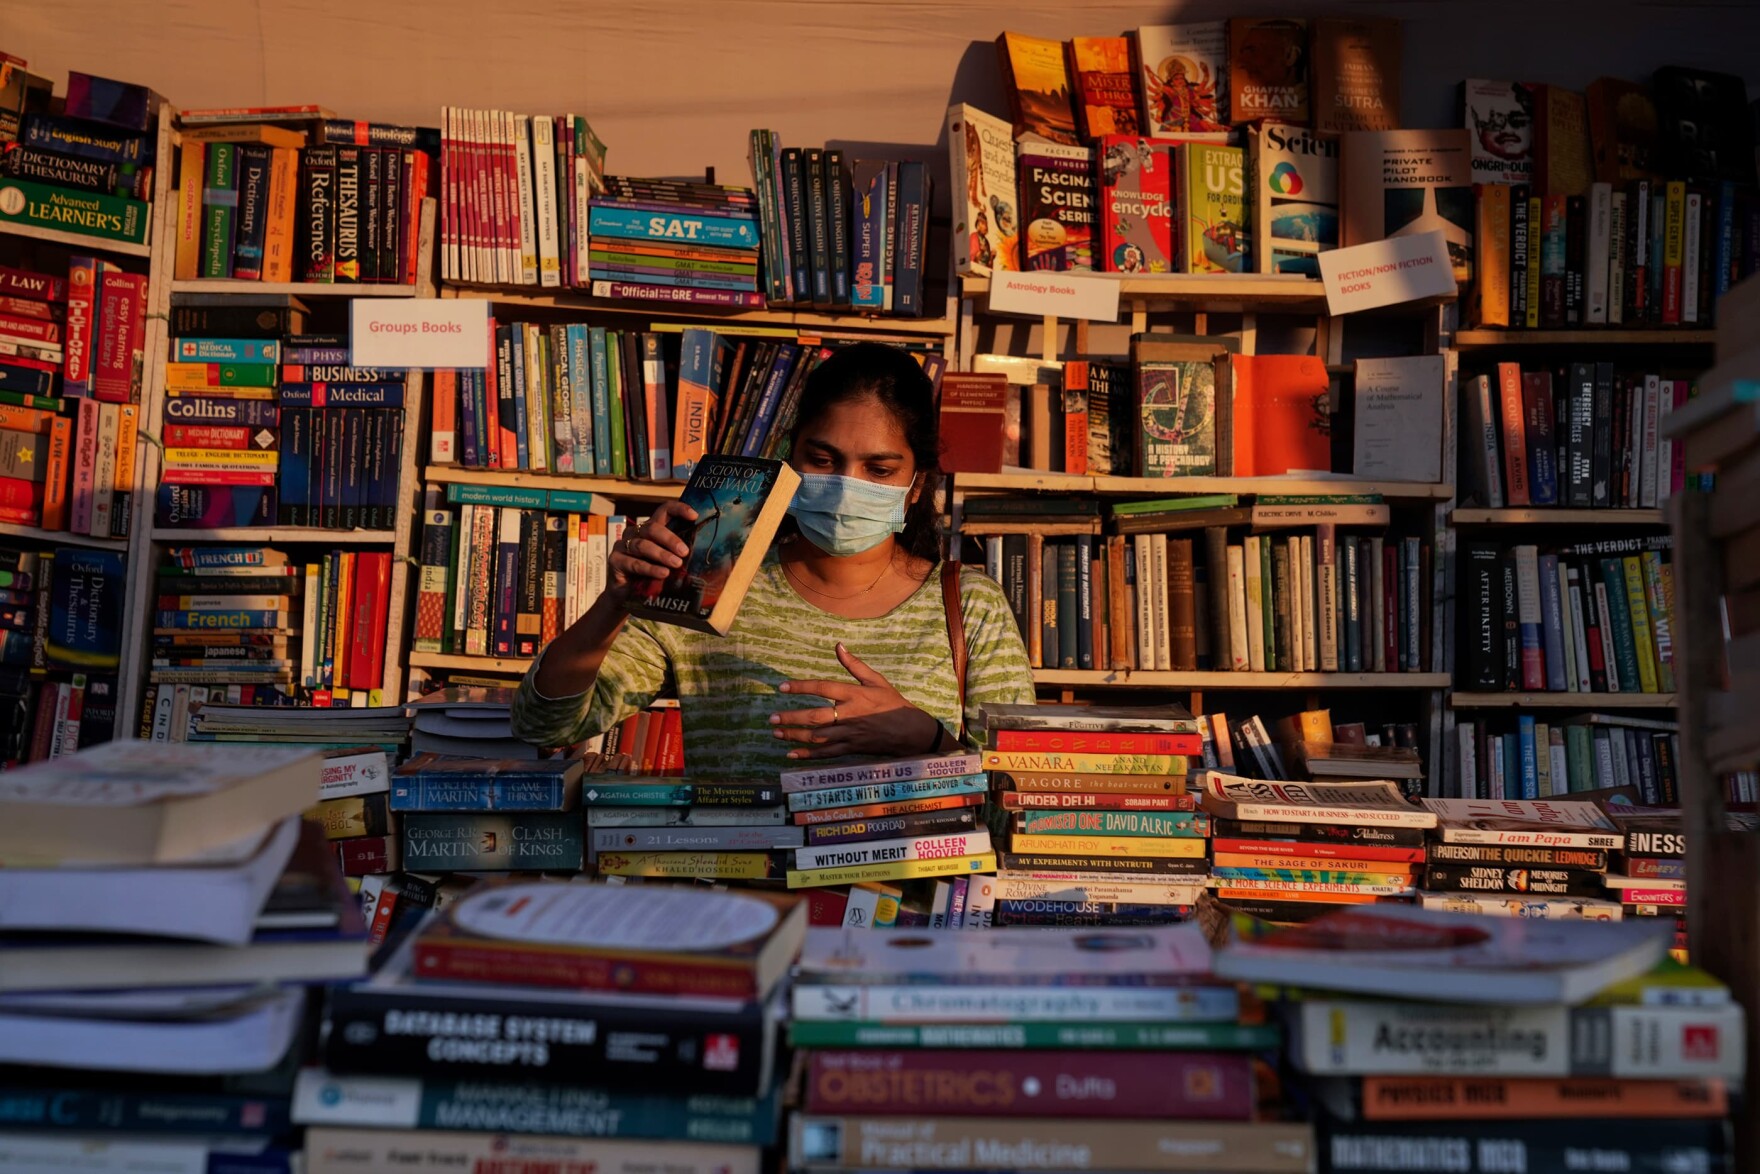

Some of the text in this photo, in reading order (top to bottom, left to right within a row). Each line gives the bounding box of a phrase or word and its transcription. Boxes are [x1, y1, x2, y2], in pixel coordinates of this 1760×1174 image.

[1244, 86, 1294, 94] GHAFFAR
[1241, 94, 1299, 108] KHAN
[1335, 95, 1383, 109] SUTRA
[325, 126, 416, 143] Oxford Biology
[1045, 148, 1072, 156] FACTS
[23, 151, 108, 176] DICTIONARY
[216, 147, 226, 185] Oxford
[22, 163, 98, 186] THESAURUS
[1383, 175, 1453, 183] HANDBOOK
[50, 193, 100, 212] Advanced
[242, 166, 261, 234] Dictionary
[887, 181, 896, 219] SECRETS
[1110, 190, 1164, 202] KNOWLEDGE
[29, 202, 122, 231] LEARNER'S
[311, 171, 330, 262] Reference
[338, 165, 358, 258] THESAURUS
[649, 217, 702, 239] SAT
[1515, 202, 1526, 266] THE VERDICT
[211, 209, 224, 275] Encyclopedia
[885, 226, 895, 271] HACKING
[675, 261, 695, 269] GMAT
[855, 222, 873, 300] SUPER BRAIN
[1338, 256, 1433, 281] FICTION/NON FICTION
[11, 275, 45, 291] LAW
[105, 278, 135, 289] Collins
[1006, 281, 1076, 296] Astrology Books
[1341, 282, 1372, 294] BOOKS
[622, 287, 658, 299] Official
[672, 289, 692, 301] GRE
[695, 292, 717, 301] General
[101, 296, 118, 368] English Library
[113, 297, 130, 369] easy learning
[369, 321, 463, 334] Groups Books
[198, 350, 236, 359] Dictionary
[199, 344, 233, 352] MEDICAL
[312, 366, 378, 382] BUSINESS
[282, 384, 385, 401] Oxford Medical
[167, 400, 236, 419] Collins
[689, 401, 702, 444] INDIA
[1484, 422, 1494, 451] INDIA
[706, 464, 760, 479] SCION OF
[1513, 456, 1523, 490] ARVIND
[693, 476, 763, 493] IKSHVAKU
[169, 485, 181, 523] Oxford
[462, 492, 541, 505] modern world history
[1573, 539, 1642, 555] THE VERDICT
[201, 552, 242, 565] FRENCH
[1504, 567, 1513, 614] MELTDOWN
[66, 575, 84, 645] Thesaurus
[84, 577, 105, 643] Dictionary
[643, 595, 690, 613] AMISH
[1480, 569, 1491, 654] AFTER PIKETTY
[187, 611, 250, 627] French
[205, 647, 246, 658] japanese
[927, 759, 967, 770] COLLEEN
[1007, 755, 1075, 771] VANARA
[1112, 756, 1147, 764] ANAND
[344, 764, 357, 773] MY
[802, 766, 912, 787] IT ENDS WITH US
[929, 767, 966, 777] HOOVER
[428, 790, 478, 803] MARTIN
[506, 791, 549, 802] THRONES
[600, 791, 666, 799] AGATHA CHRISTIE
[697, 787, 755, 796] The Mysterious
[1018, 793, 1169, 807] UNDER DELHI SORABH PANT
[816, 820, 906, 838] RICH DAD POOR DAD
[1027, 813, 1173, 835] PROMISED ONE DAVID ALRIC
[512, 827, 562, 841] CLASH
[647, 835, 719, 845] 21 Lessons
[408, 840, 480, 857] MARTIN
[519, 843, 563, 856] KINGS
[915, 837, 967, 851] COLLEEN
[1019, 840, 1100, 851] ARUNDHATI ROY
[815, 847, 908, 867] WITHOUT MERIT
[918, 847, 965, 860] HOOVER
[1437, 845, 1598, 866] PATTERSON THE QUICKIE LEDWIDGE
[636, 854, 752, 870] A Thousand Splendid Suns
[1018, 858, 1031, 866] MY
[1033, 858, 1088, 867] EXPERIMENTS
[1113, 861, 1153, 869] UNTRUTH
[1471, 867, 1504, 878] SIDNEY
[1530, 870, 1569, 881] MEMORIES
[1235, 879, 1360, 893] MORE SCIENCE EXPERIMENTS
[1460, 877, 1504, 890] SHELDON
[1529, 882, 1568, 893] MIDNIGHT
[1009, 900, 1100, 914] WODEHOUSE
[892, 988, 1100, 1015] Chromatography
[385, 1010, 597, 1046] DATABASE SYSTEM
[920, 1026, 1027, 1047] MATHEMATICS
[1373, 1022, 1548, 1063] Accounting
[427, 1038, 551, 1067] CONCEPTS
[818, 1071, 1016, 1106] OBSTETRICS
[435, 1102, 623, 1136] MANAGEMENT
[861, 1136, 1092, 1168] Practical Medicine
[1330, 1135, 1529, 1173] MATHEMATICS MCQ
